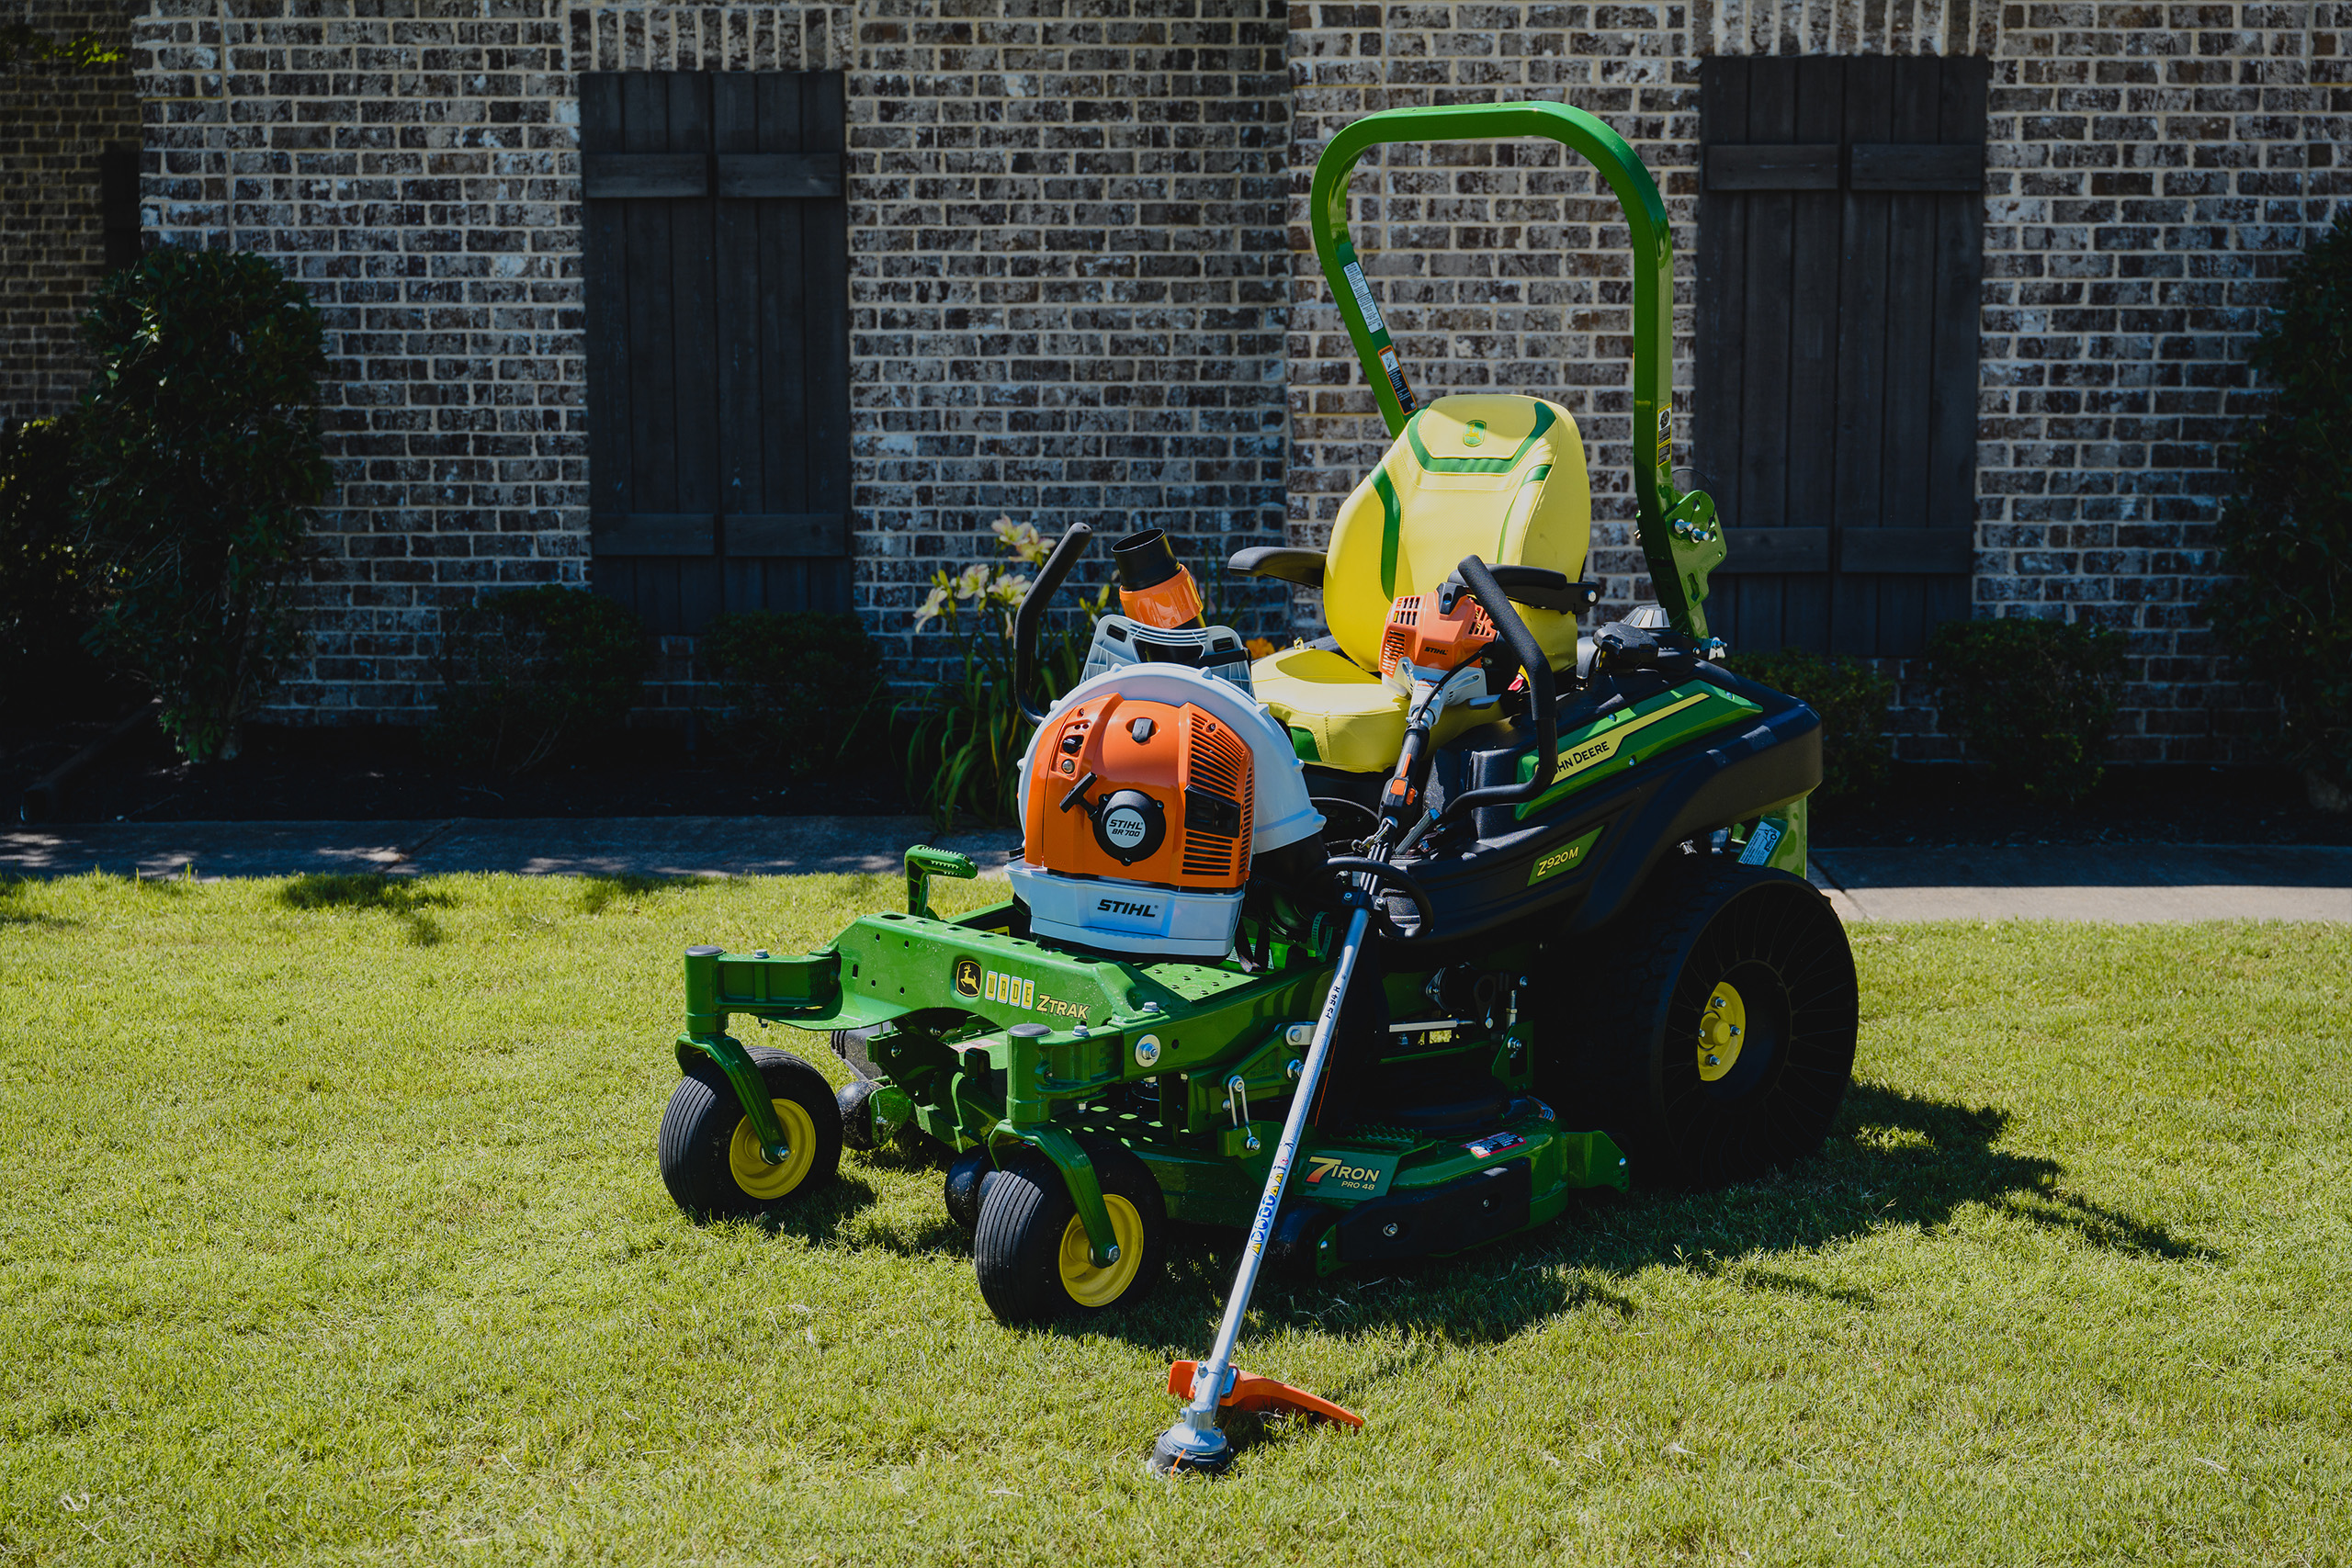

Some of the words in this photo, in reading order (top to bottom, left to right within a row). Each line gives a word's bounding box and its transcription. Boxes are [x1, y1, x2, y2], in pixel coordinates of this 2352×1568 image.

[1424, 646, 1448, 655] STIHL
[1555, 757, 1574, 774] HN
[1573, 741, 1610, 764] DEERE
[1109, 818, 1142, 830] STIHL
[1112, 828, 1125, 836] BR
[1536, 846, 1579, 877] Z920M
[1097, 898, 1157, 918] STIHL
[988, 976, 1033, 1005] WADE
[1035, 994, 1091, 1020] ZTRAK
[1341, 1180, 1361, 1189] PRO
